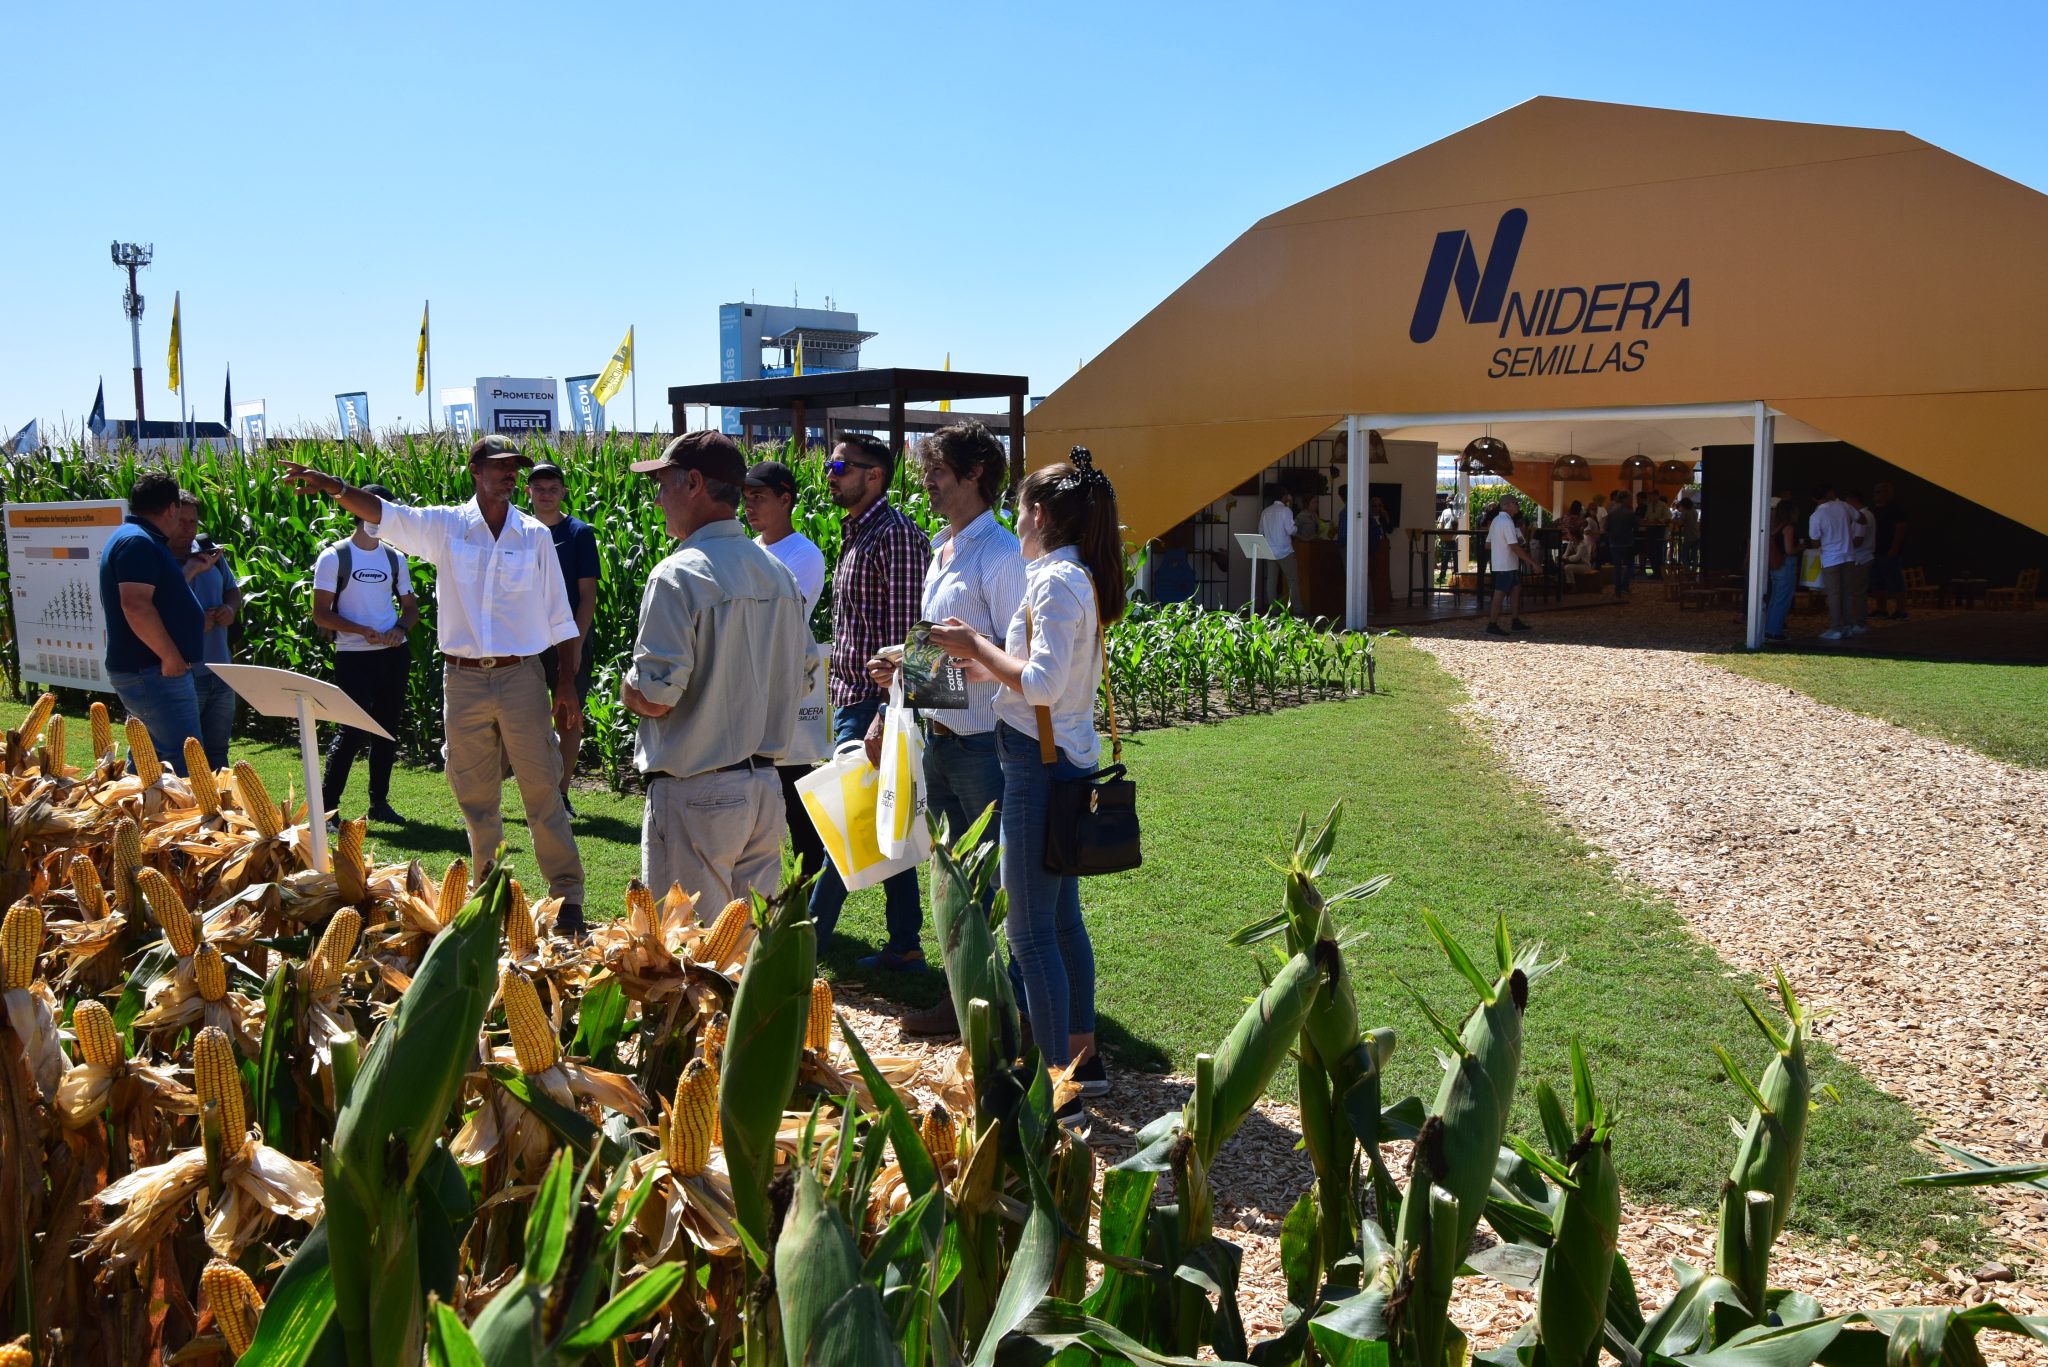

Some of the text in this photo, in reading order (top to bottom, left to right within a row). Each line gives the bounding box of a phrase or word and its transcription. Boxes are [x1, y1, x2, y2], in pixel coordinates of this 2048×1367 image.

[1499, 277, 1690, 339] NIDERA
[1487, 339, 1649, 379] SEMILLAS
[490, 389, 555, 400] PROMETEON
[499, 413, 548, 428] PIRELLI
